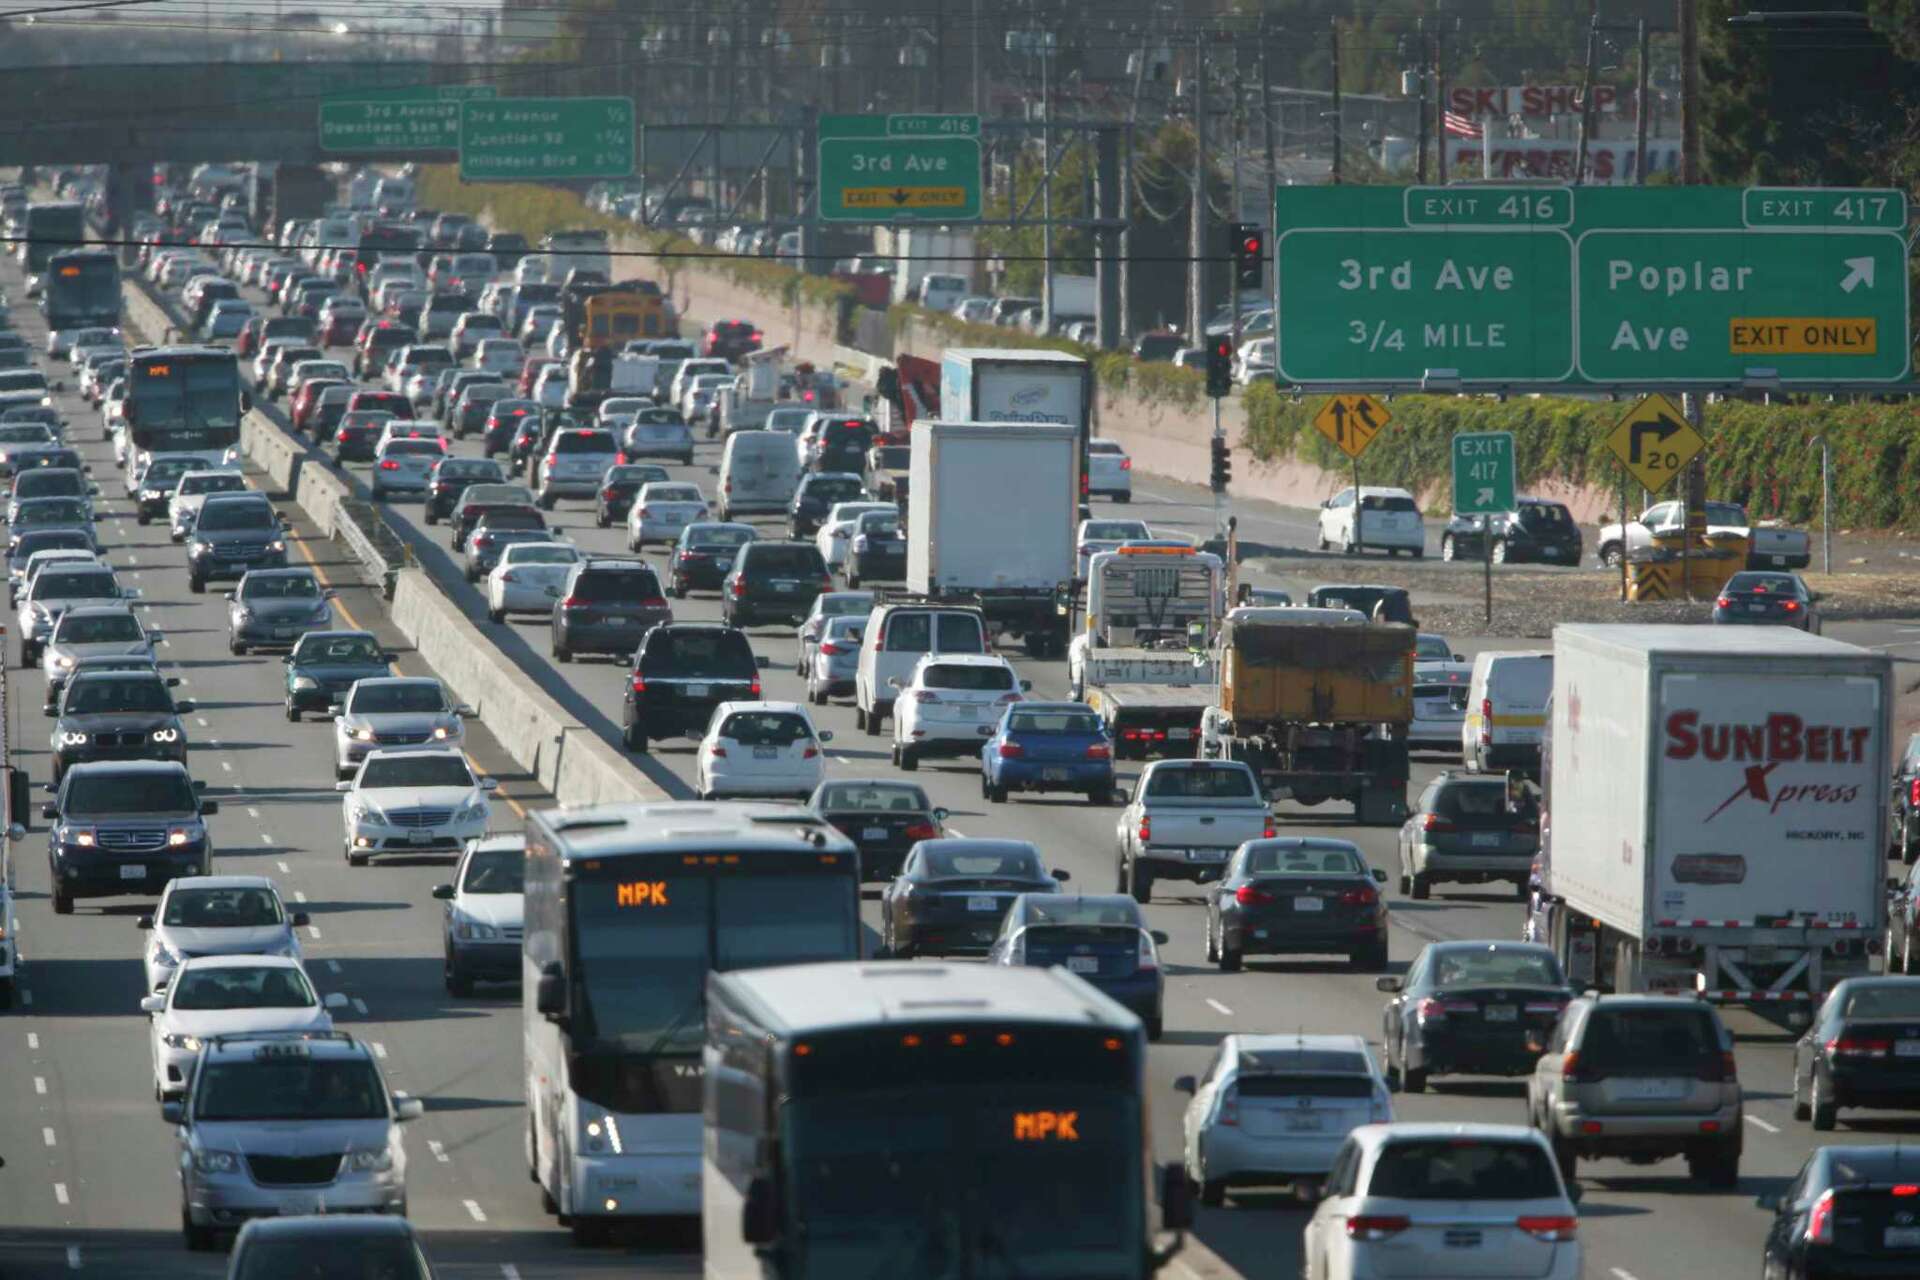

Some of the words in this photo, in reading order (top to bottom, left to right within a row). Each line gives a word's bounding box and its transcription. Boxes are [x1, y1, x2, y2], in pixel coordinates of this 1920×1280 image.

[363, 104, 391, 118] 3rd
[400, 105, 456, 118] Avenue
[1451, 87, 1509, 114] SKI
[468, 110, 496, 123] 3rd
[503, 110, 560, 123] Avenue
[897, 120, 927, 131] EXIT
[939, 119, 971, 133] 416
[323, 121, 403, 135] Downtown
[409, 121, 438, 133] San
[468, 130, 539, 147] Junction
[468, 153, 536, 168] Hillsdale
[543, 153, 577, 168] Blvd
[851, 154, 892, 171] 3rd
[904, 154, 948, 171] Ave
[847, 192, 878, 205] EXIT
[918, 192, 960, 205] ONLY
[1424, 199, 1479, 215] EXIT
[1498, 195, 1555, 219] 416
[1762, 200, 1813, 216] EXIT
[1833, 198, 1888, 221] 417
[1338, 258, 1412, 291] 3rd
[1435, 258, 1514, 291] Ave
[1608, 260, 1753, 297] Poplar
[1348, 319, 1406, 353] 3/4
[1424, 323, 1507, 348] MILE
[1610, 320, 1690, 351] Ave
[1733, 325, 1790, 346] EXIT
[1804, 325, 1873, 346] ONLY
[1460, 438, 1506, 457] EXIT
[1469, 461, 1498, 482] 417
[1647, 452, 1680, 470] 20
[1704, 762, 1862, 824] Xpress
[1785, 830, 1844, 842] HICKORY,
[1847, 830, 1865, 842] NC
[616, 880, 668, 907] MPK
[1014, 1109, 1080, 1141] MPK
